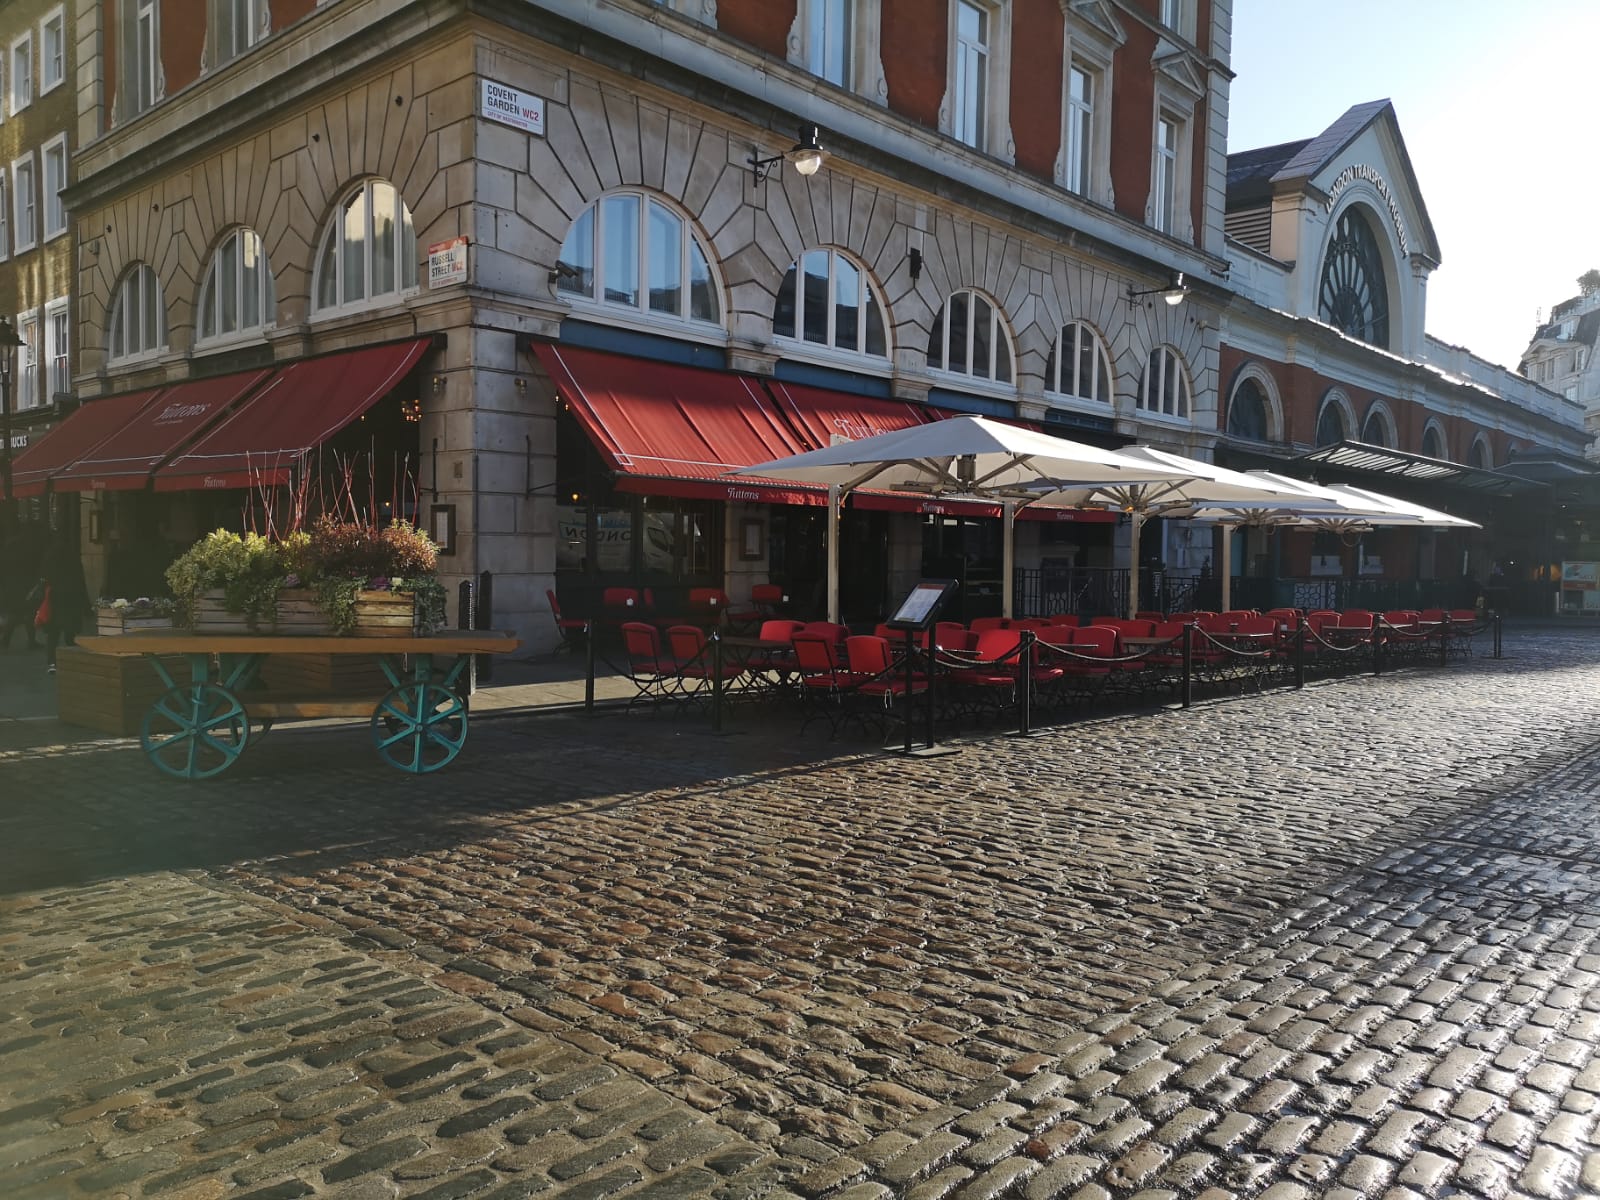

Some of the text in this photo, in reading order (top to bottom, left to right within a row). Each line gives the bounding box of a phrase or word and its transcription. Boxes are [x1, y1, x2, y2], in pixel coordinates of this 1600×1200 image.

[487, 84, 517, 103] COVENT
[487, 96, 539, 121] GARDEN WC2
[1325, 164, 1409, 259] LONDON TRANSPORT MUSEUM
[431, 252, 454, 265] RUSSELL
[431, 263, 451, 278] STREET
[727, 487, 760, 500] Tuttons
